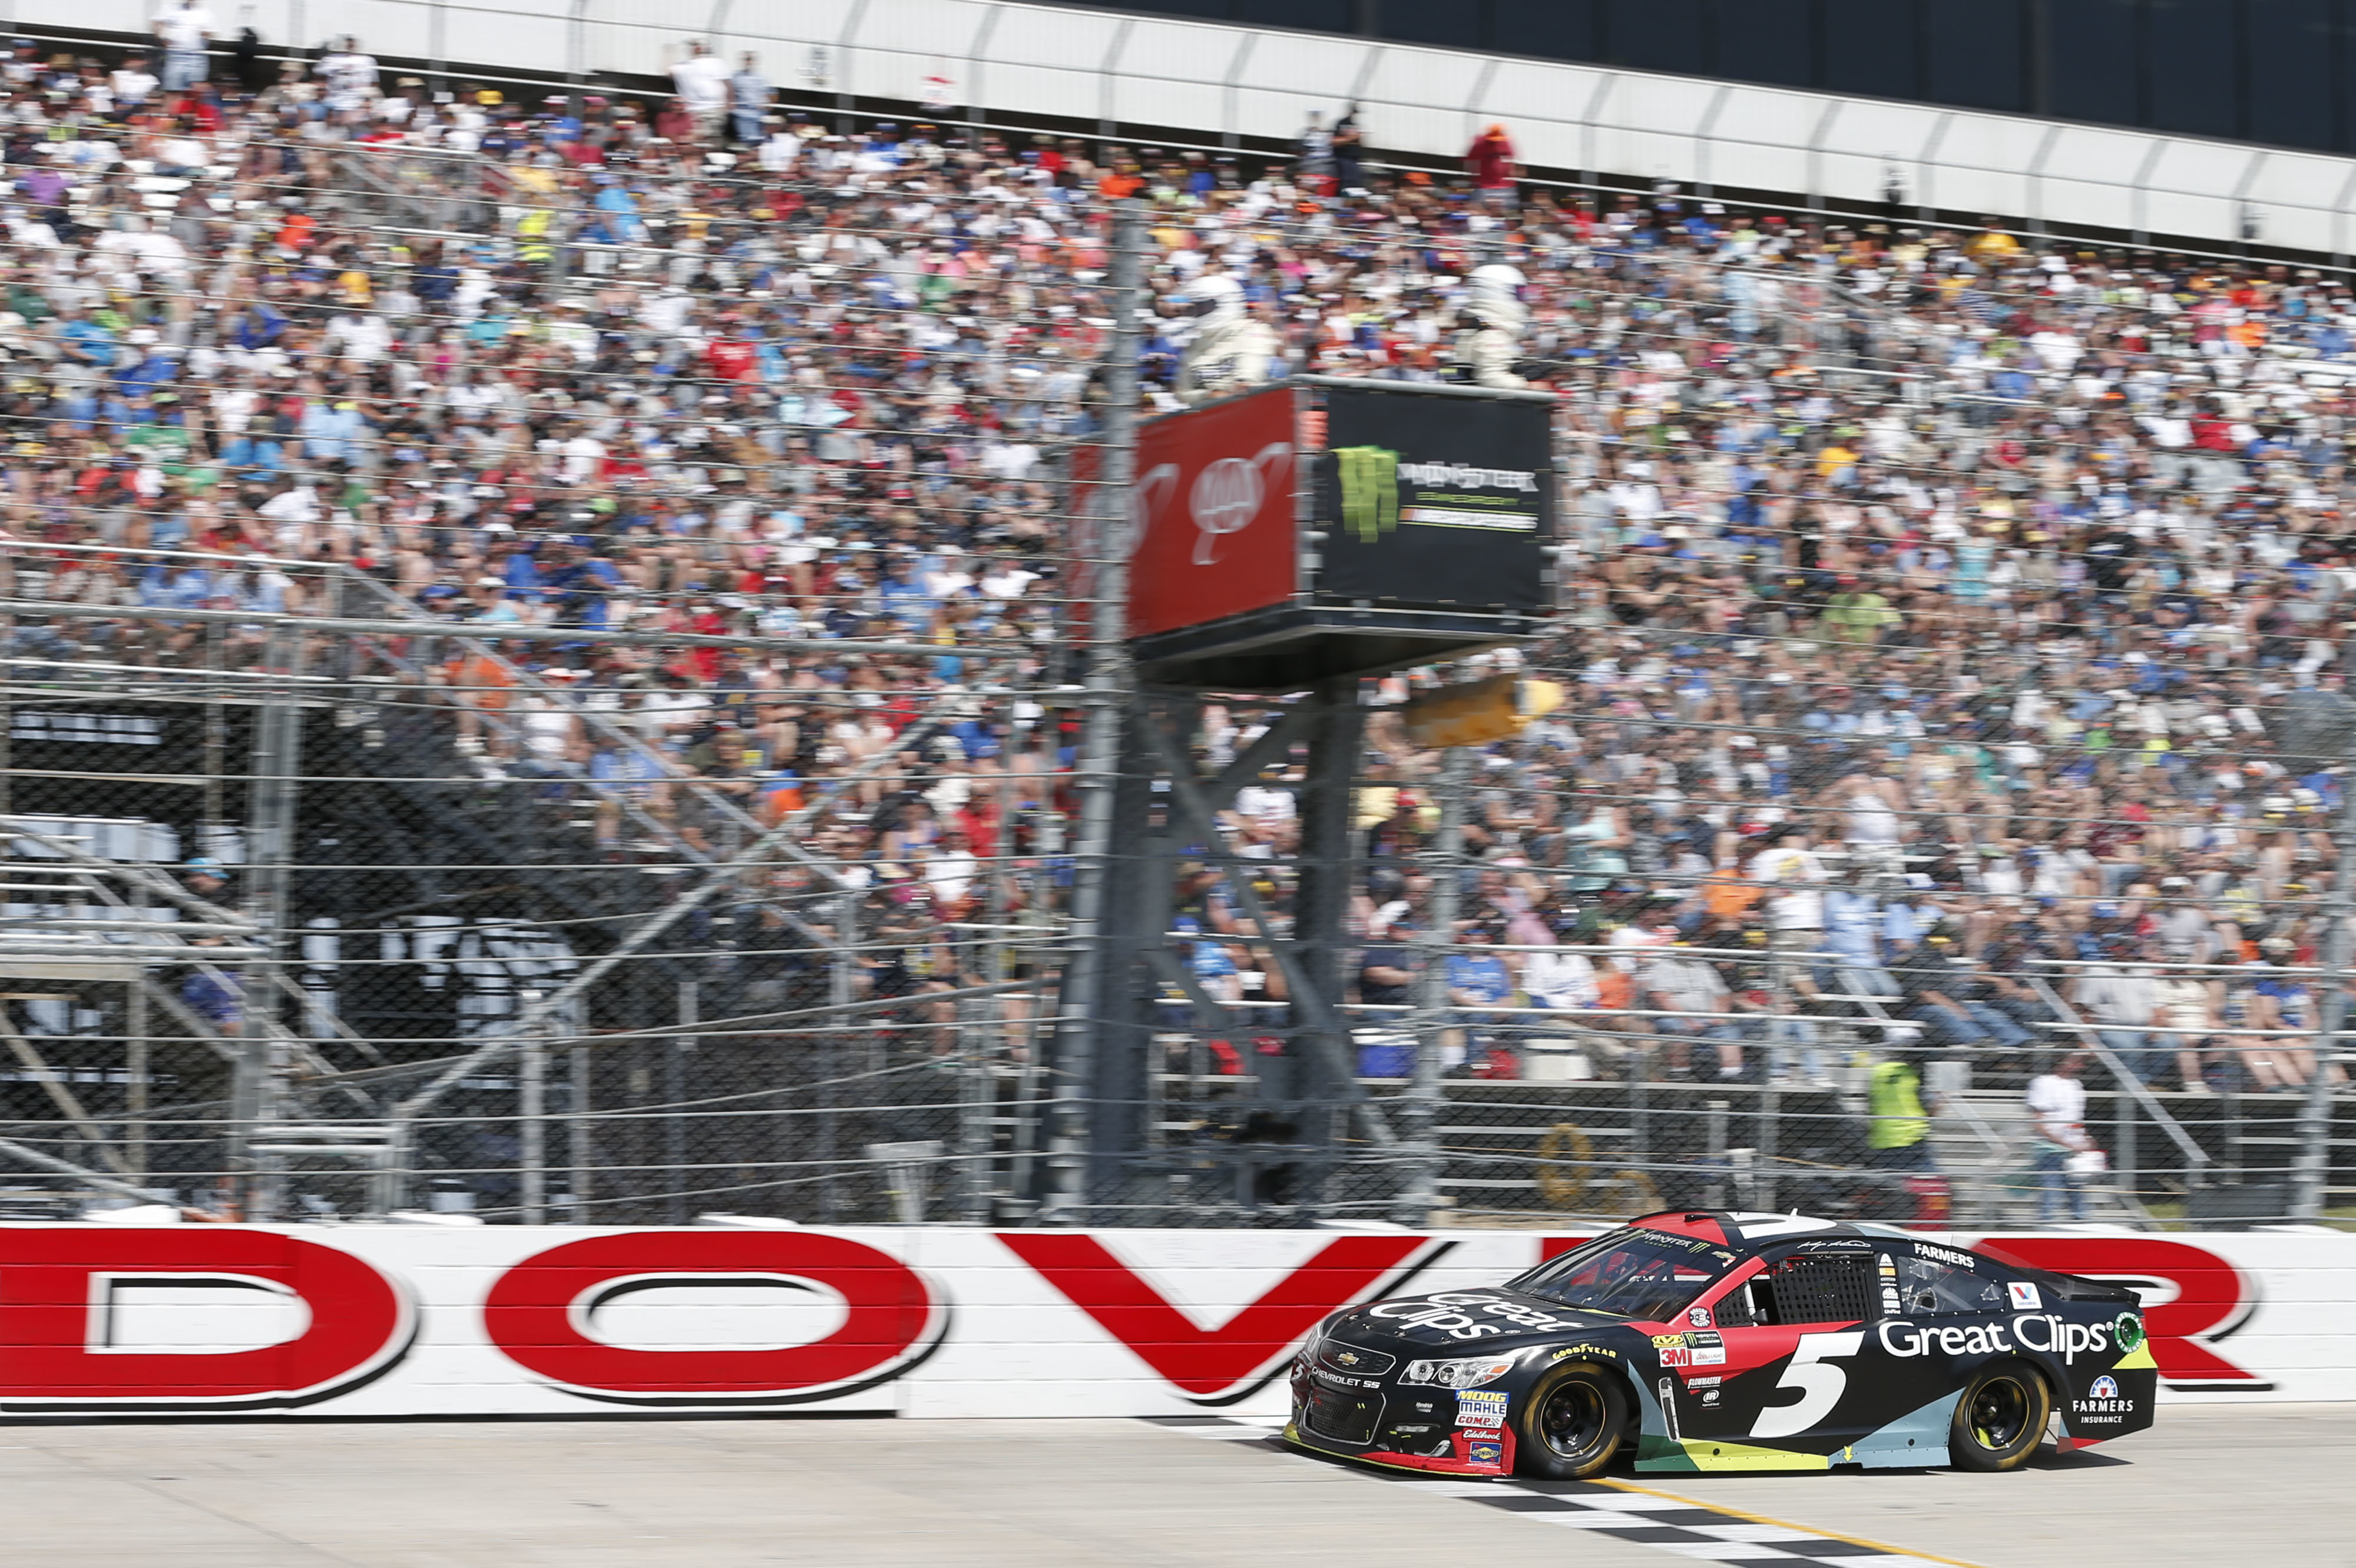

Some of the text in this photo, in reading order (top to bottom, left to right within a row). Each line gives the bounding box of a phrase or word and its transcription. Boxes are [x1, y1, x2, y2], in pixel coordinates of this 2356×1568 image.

[1914, 1243, 1975, 1268] FARMERS
[1369, 1302, 1501, 1339] Clips
[1427, 1294, 1585, 1332] Great
[2115, 1312, 2143, 1329] AMERICAN
[1878, 1314, 2108, 1365] Great Clips
[2117, 1338, 2143, 1353] ETHANOL
[1553, 1344, 1617, 1360] GOODYEAR
[1662, 1349, 1686, 1365] 3M
[1312, 1367, 1381, 1389] CHEVROLET SS
[1687, 1377, 1722, 1389] FLOWMASTER
[1749, 1331, 1866, 1438] 5
[1457, 1391, 1508, 1402] MOOG
[1461, 1402, 1505, 1414] MAHLE
[2073, 1400, 2134, 1412] FARMERS
[1458, 1415, 1491, 1424] COMP
[1463, 1430, 1501, 1440] Edelbrock
